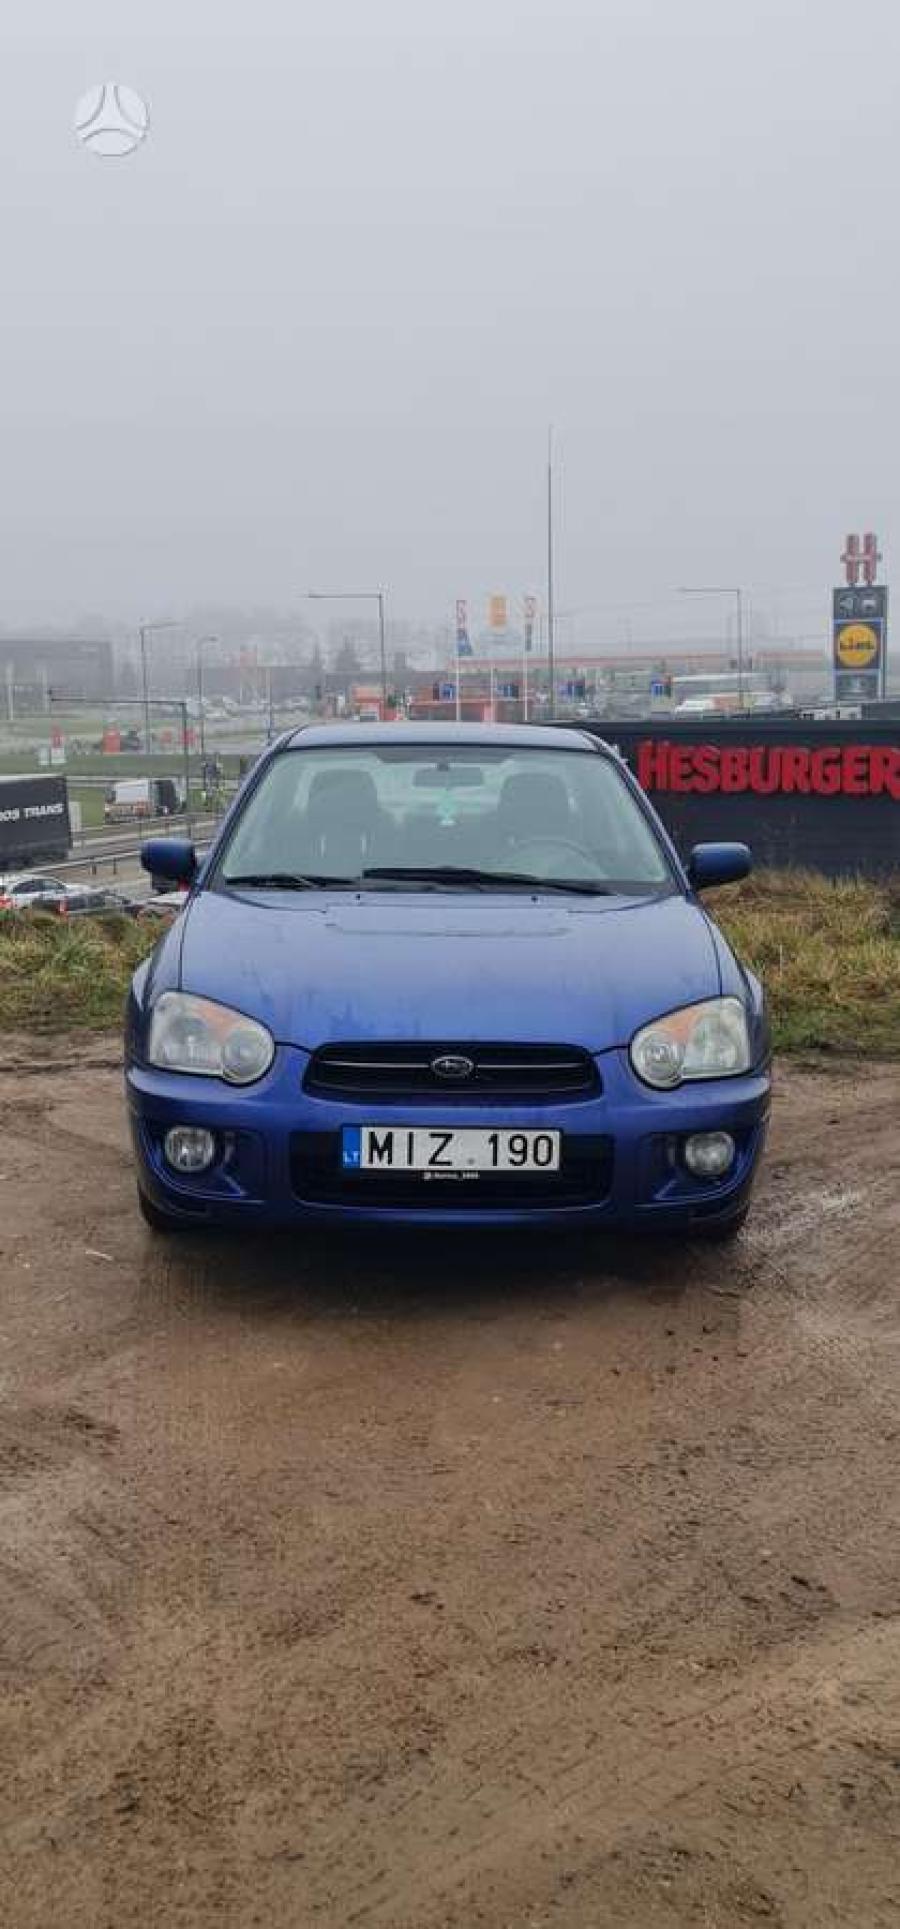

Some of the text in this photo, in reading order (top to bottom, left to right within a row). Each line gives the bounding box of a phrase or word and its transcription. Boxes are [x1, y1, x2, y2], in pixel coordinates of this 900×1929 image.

[636, 740, 900, 800] HESBURGER
[343, 1150, 359, 1163] LT
[368, 1131, 554, 1167] MIZ 190
